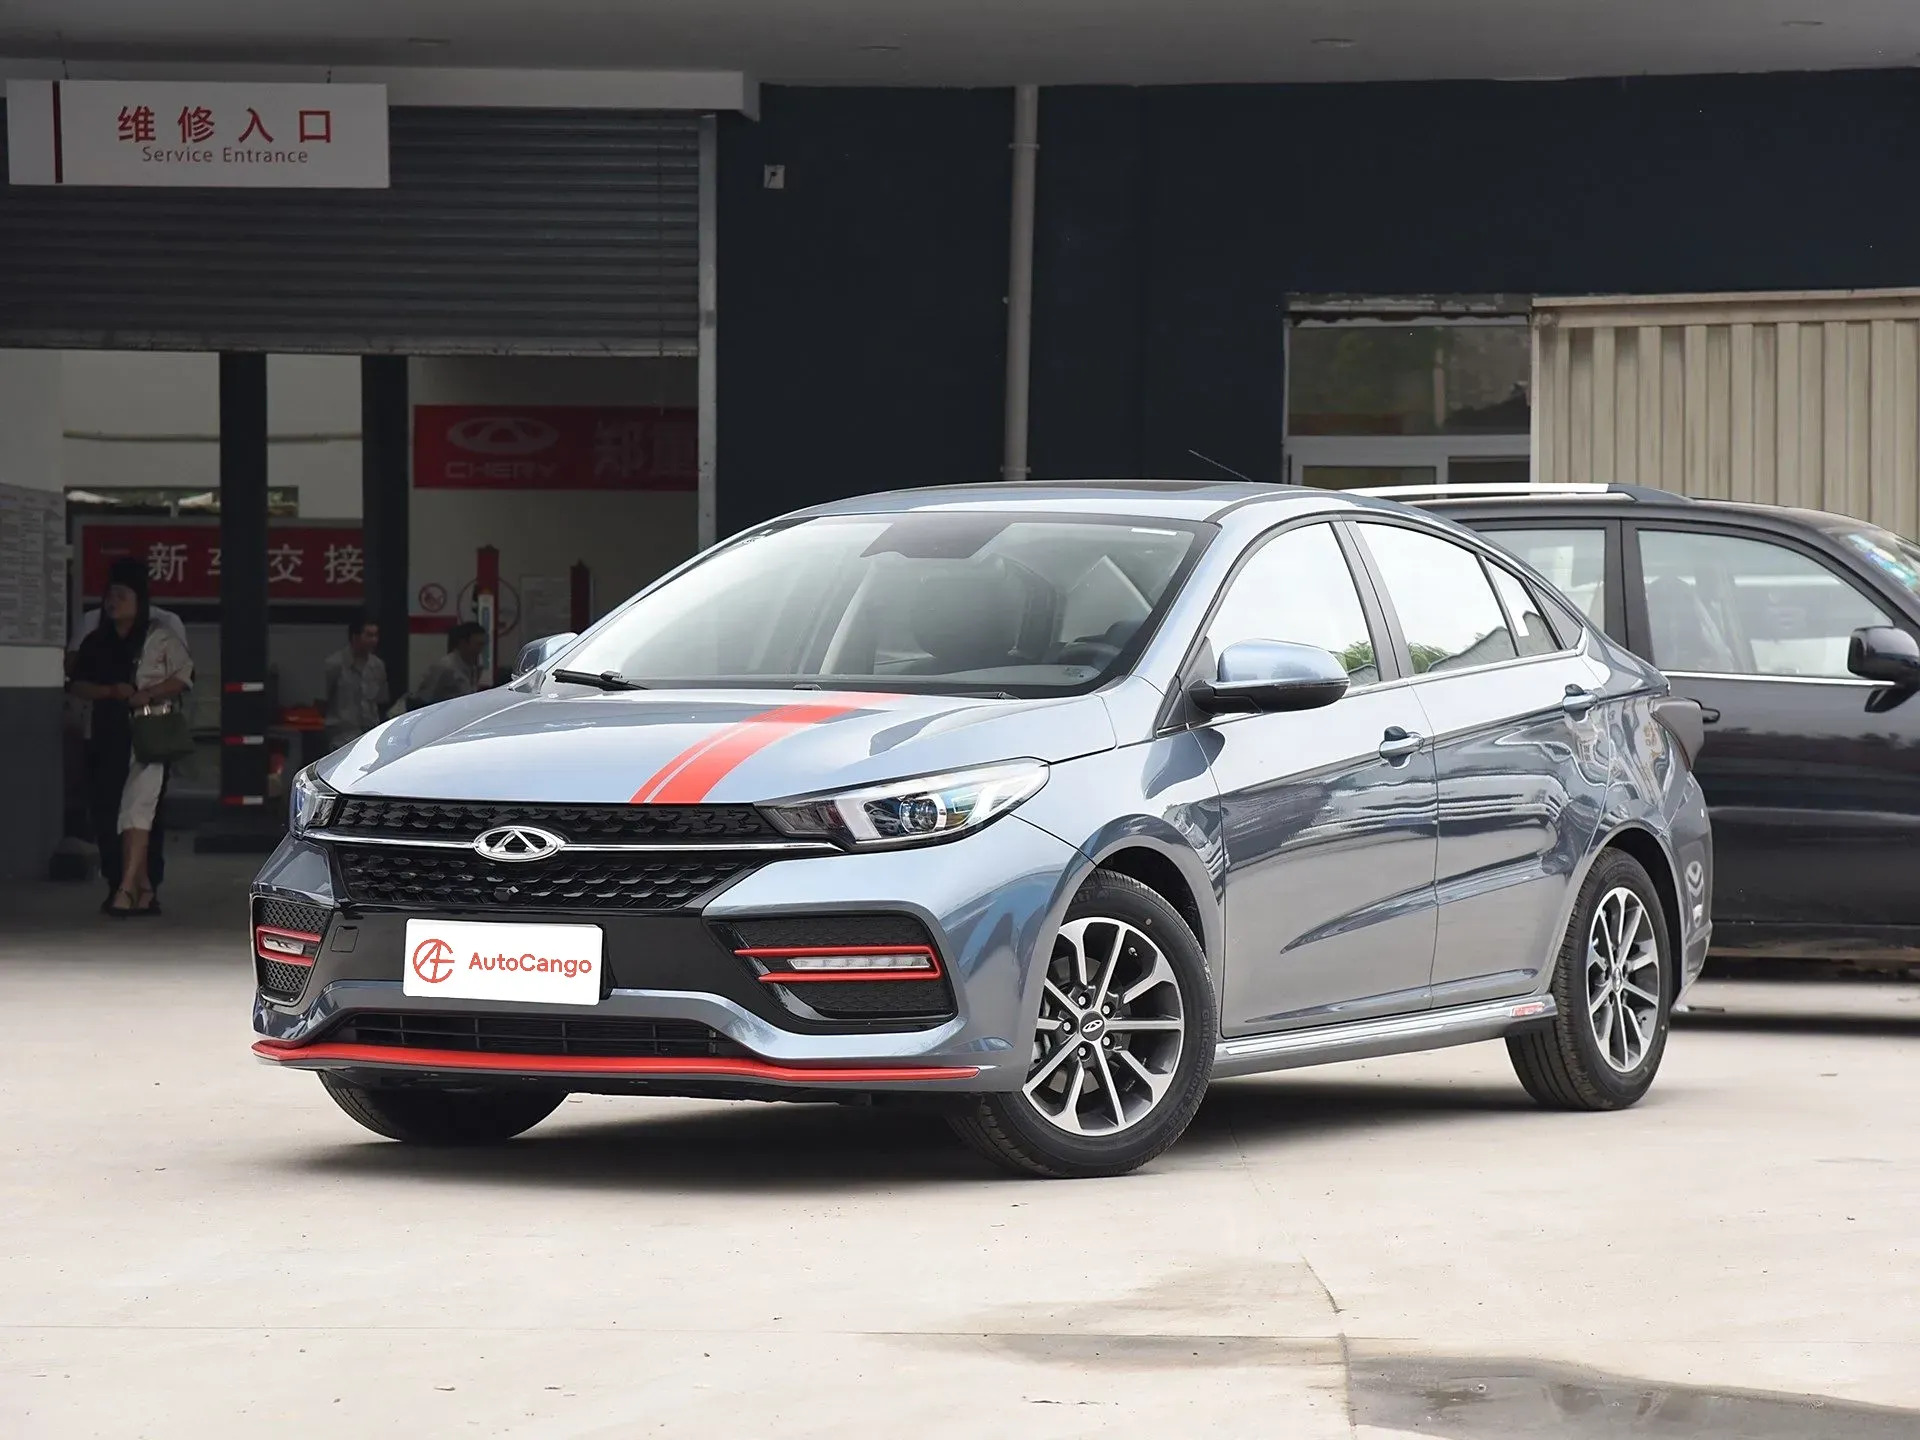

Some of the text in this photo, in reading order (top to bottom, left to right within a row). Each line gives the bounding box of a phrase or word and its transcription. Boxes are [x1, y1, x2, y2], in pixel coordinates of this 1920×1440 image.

[117, 105, 332, 144] 维修入口
[142, 146, 308, 165] Service Entrance
[444, 460, 559, 480] CHERY
